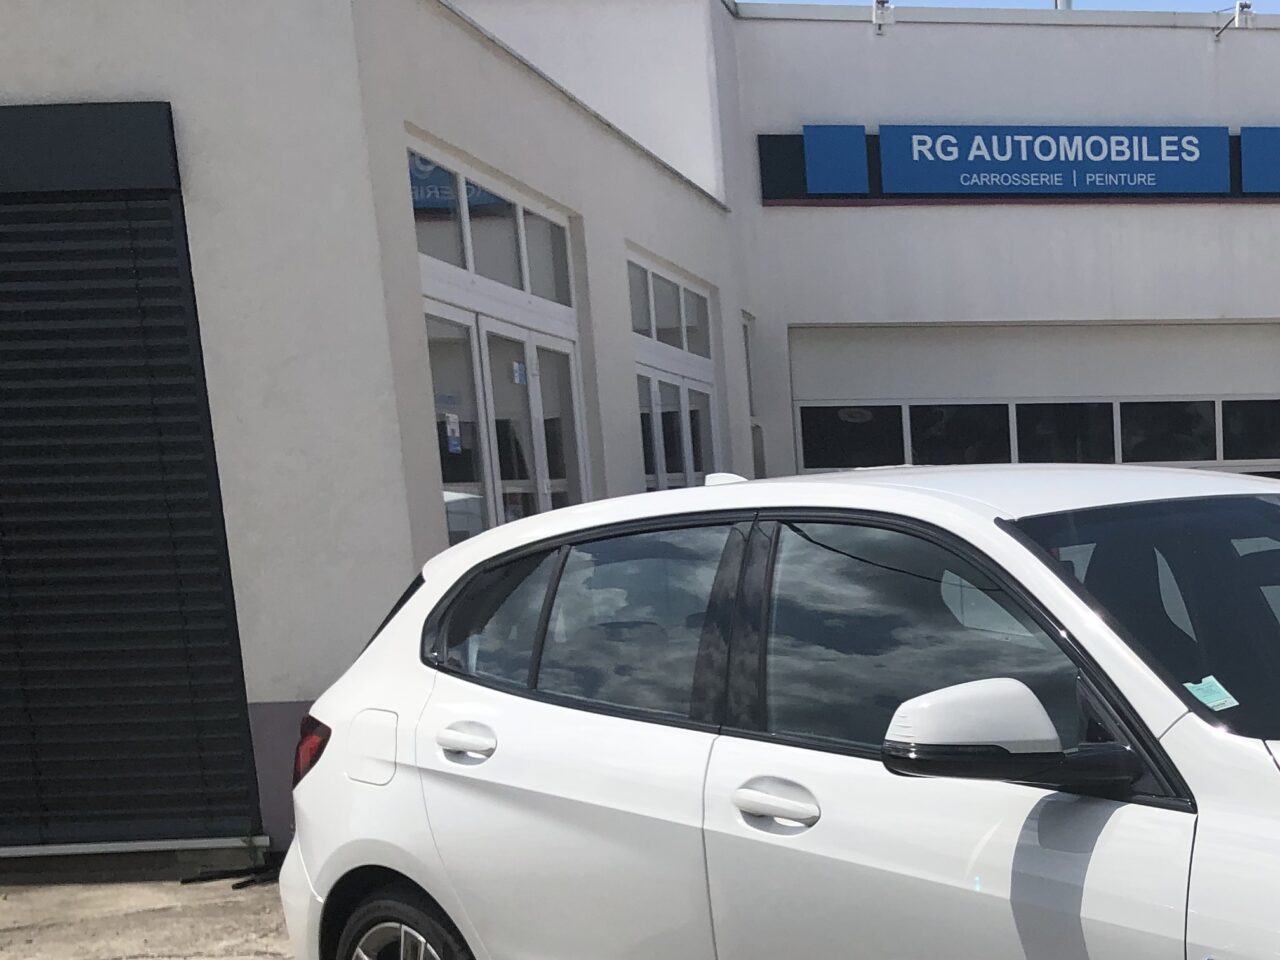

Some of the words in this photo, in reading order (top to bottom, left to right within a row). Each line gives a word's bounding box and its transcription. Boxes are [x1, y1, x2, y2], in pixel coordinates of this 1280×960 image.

[911, 134, 959, 161] RG
[967, 134, 1200, 162] AUTOMOBILES
[960, 173, 1063, 186] CARROSSERIE
[1086, 173, 1156, 186] PEINTURE
